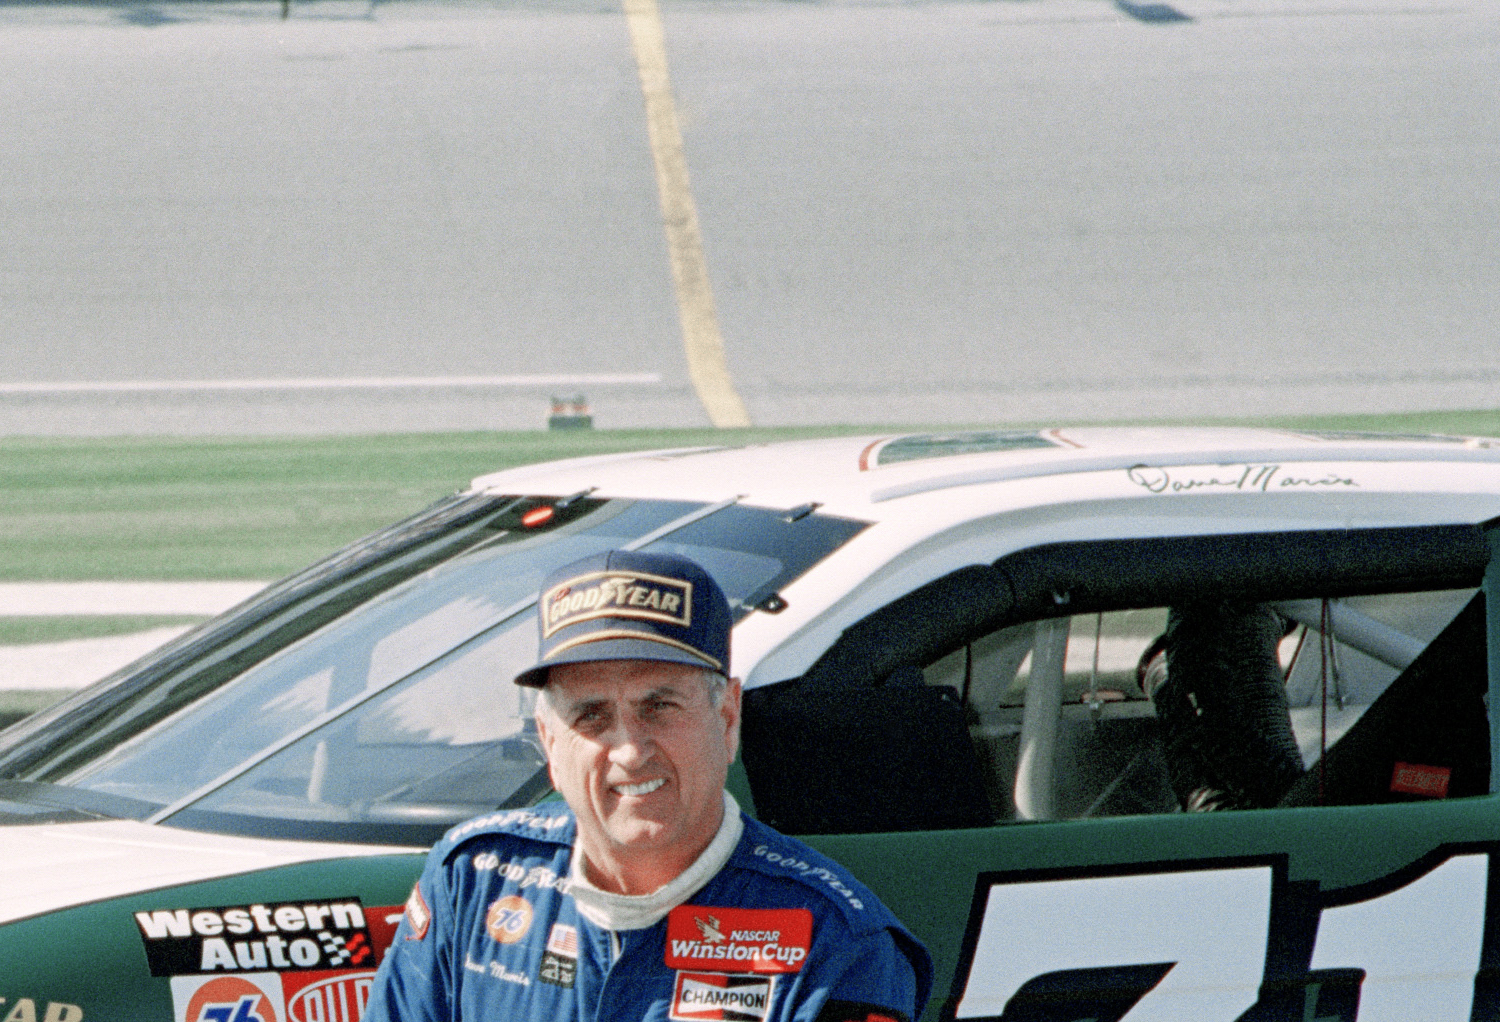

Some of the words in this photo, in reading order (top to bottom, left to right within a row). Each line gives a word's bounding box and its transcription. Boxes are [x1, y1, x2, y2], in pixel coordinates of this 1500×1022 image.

[550, 577, 682, 624] GOODYEAR
[135, 903, 366, 938] Western
[491, 907, 527, 933] 76
[729, 931, 780, 942] NASCAR
[201, 935, 321, 971] Auto
[681, 989, 766, 1008] CHAMPION
